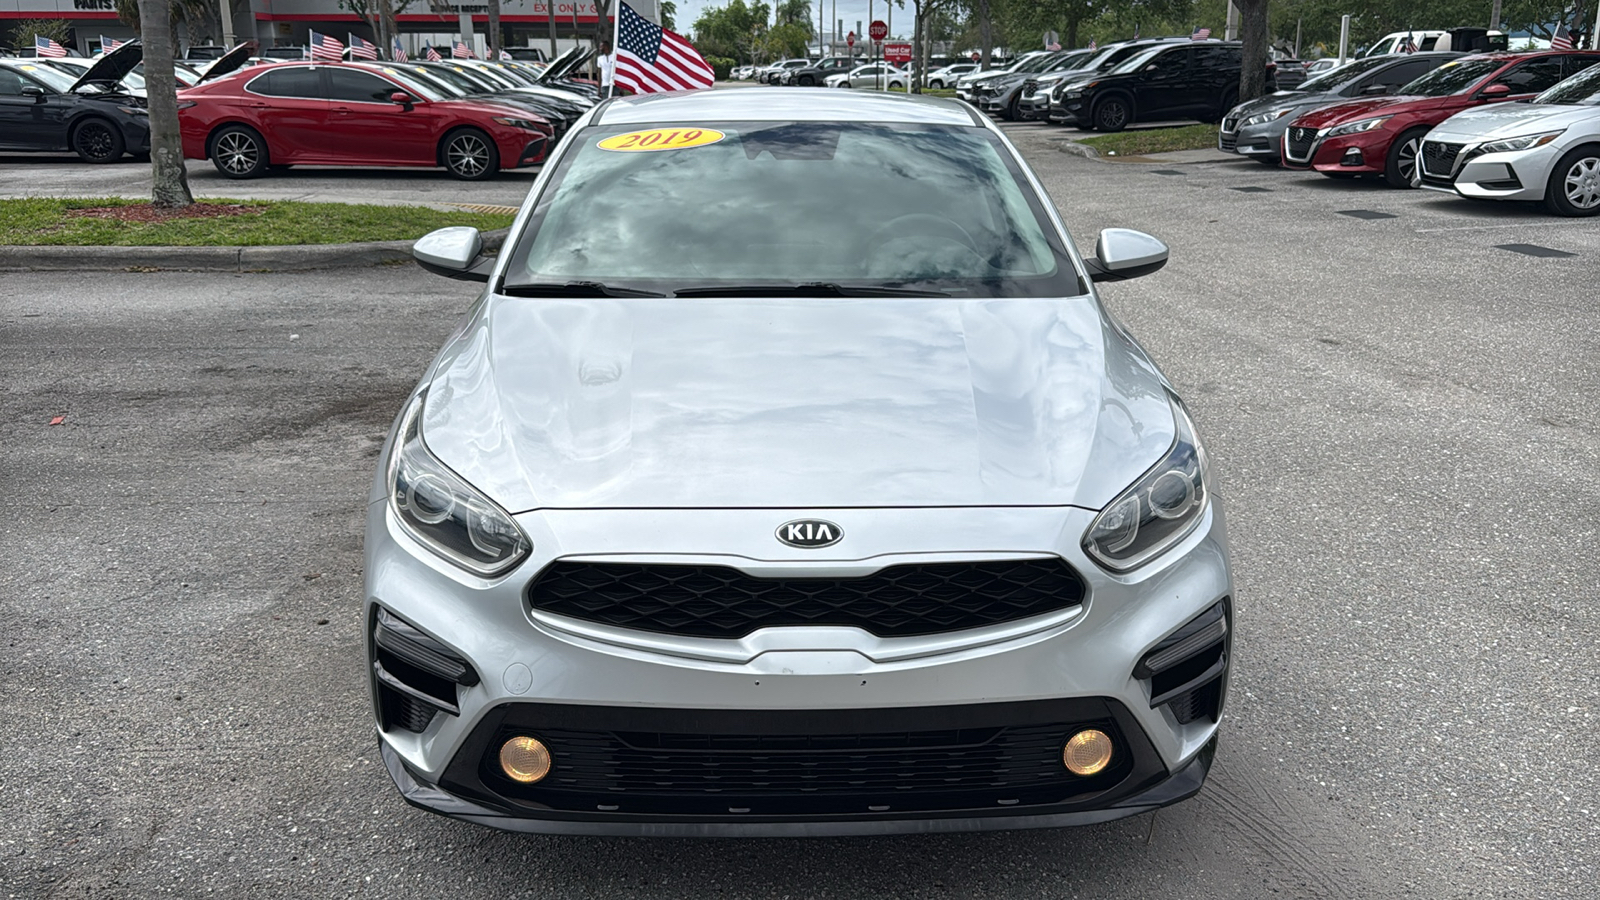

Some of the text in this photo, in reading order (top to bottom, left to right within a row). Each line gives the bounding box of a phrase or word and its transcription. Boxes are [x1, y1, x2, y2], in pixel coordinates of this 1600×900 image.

[74, 0, 113, 9] PARTS
[430, 5, 459, 13] SRVICE
[534, 4, 556, 13] EX
[870, 26, 887, 35] STOP
[616, 130, 703, 148] 2019
[788, 524, 833, 540] KIA
